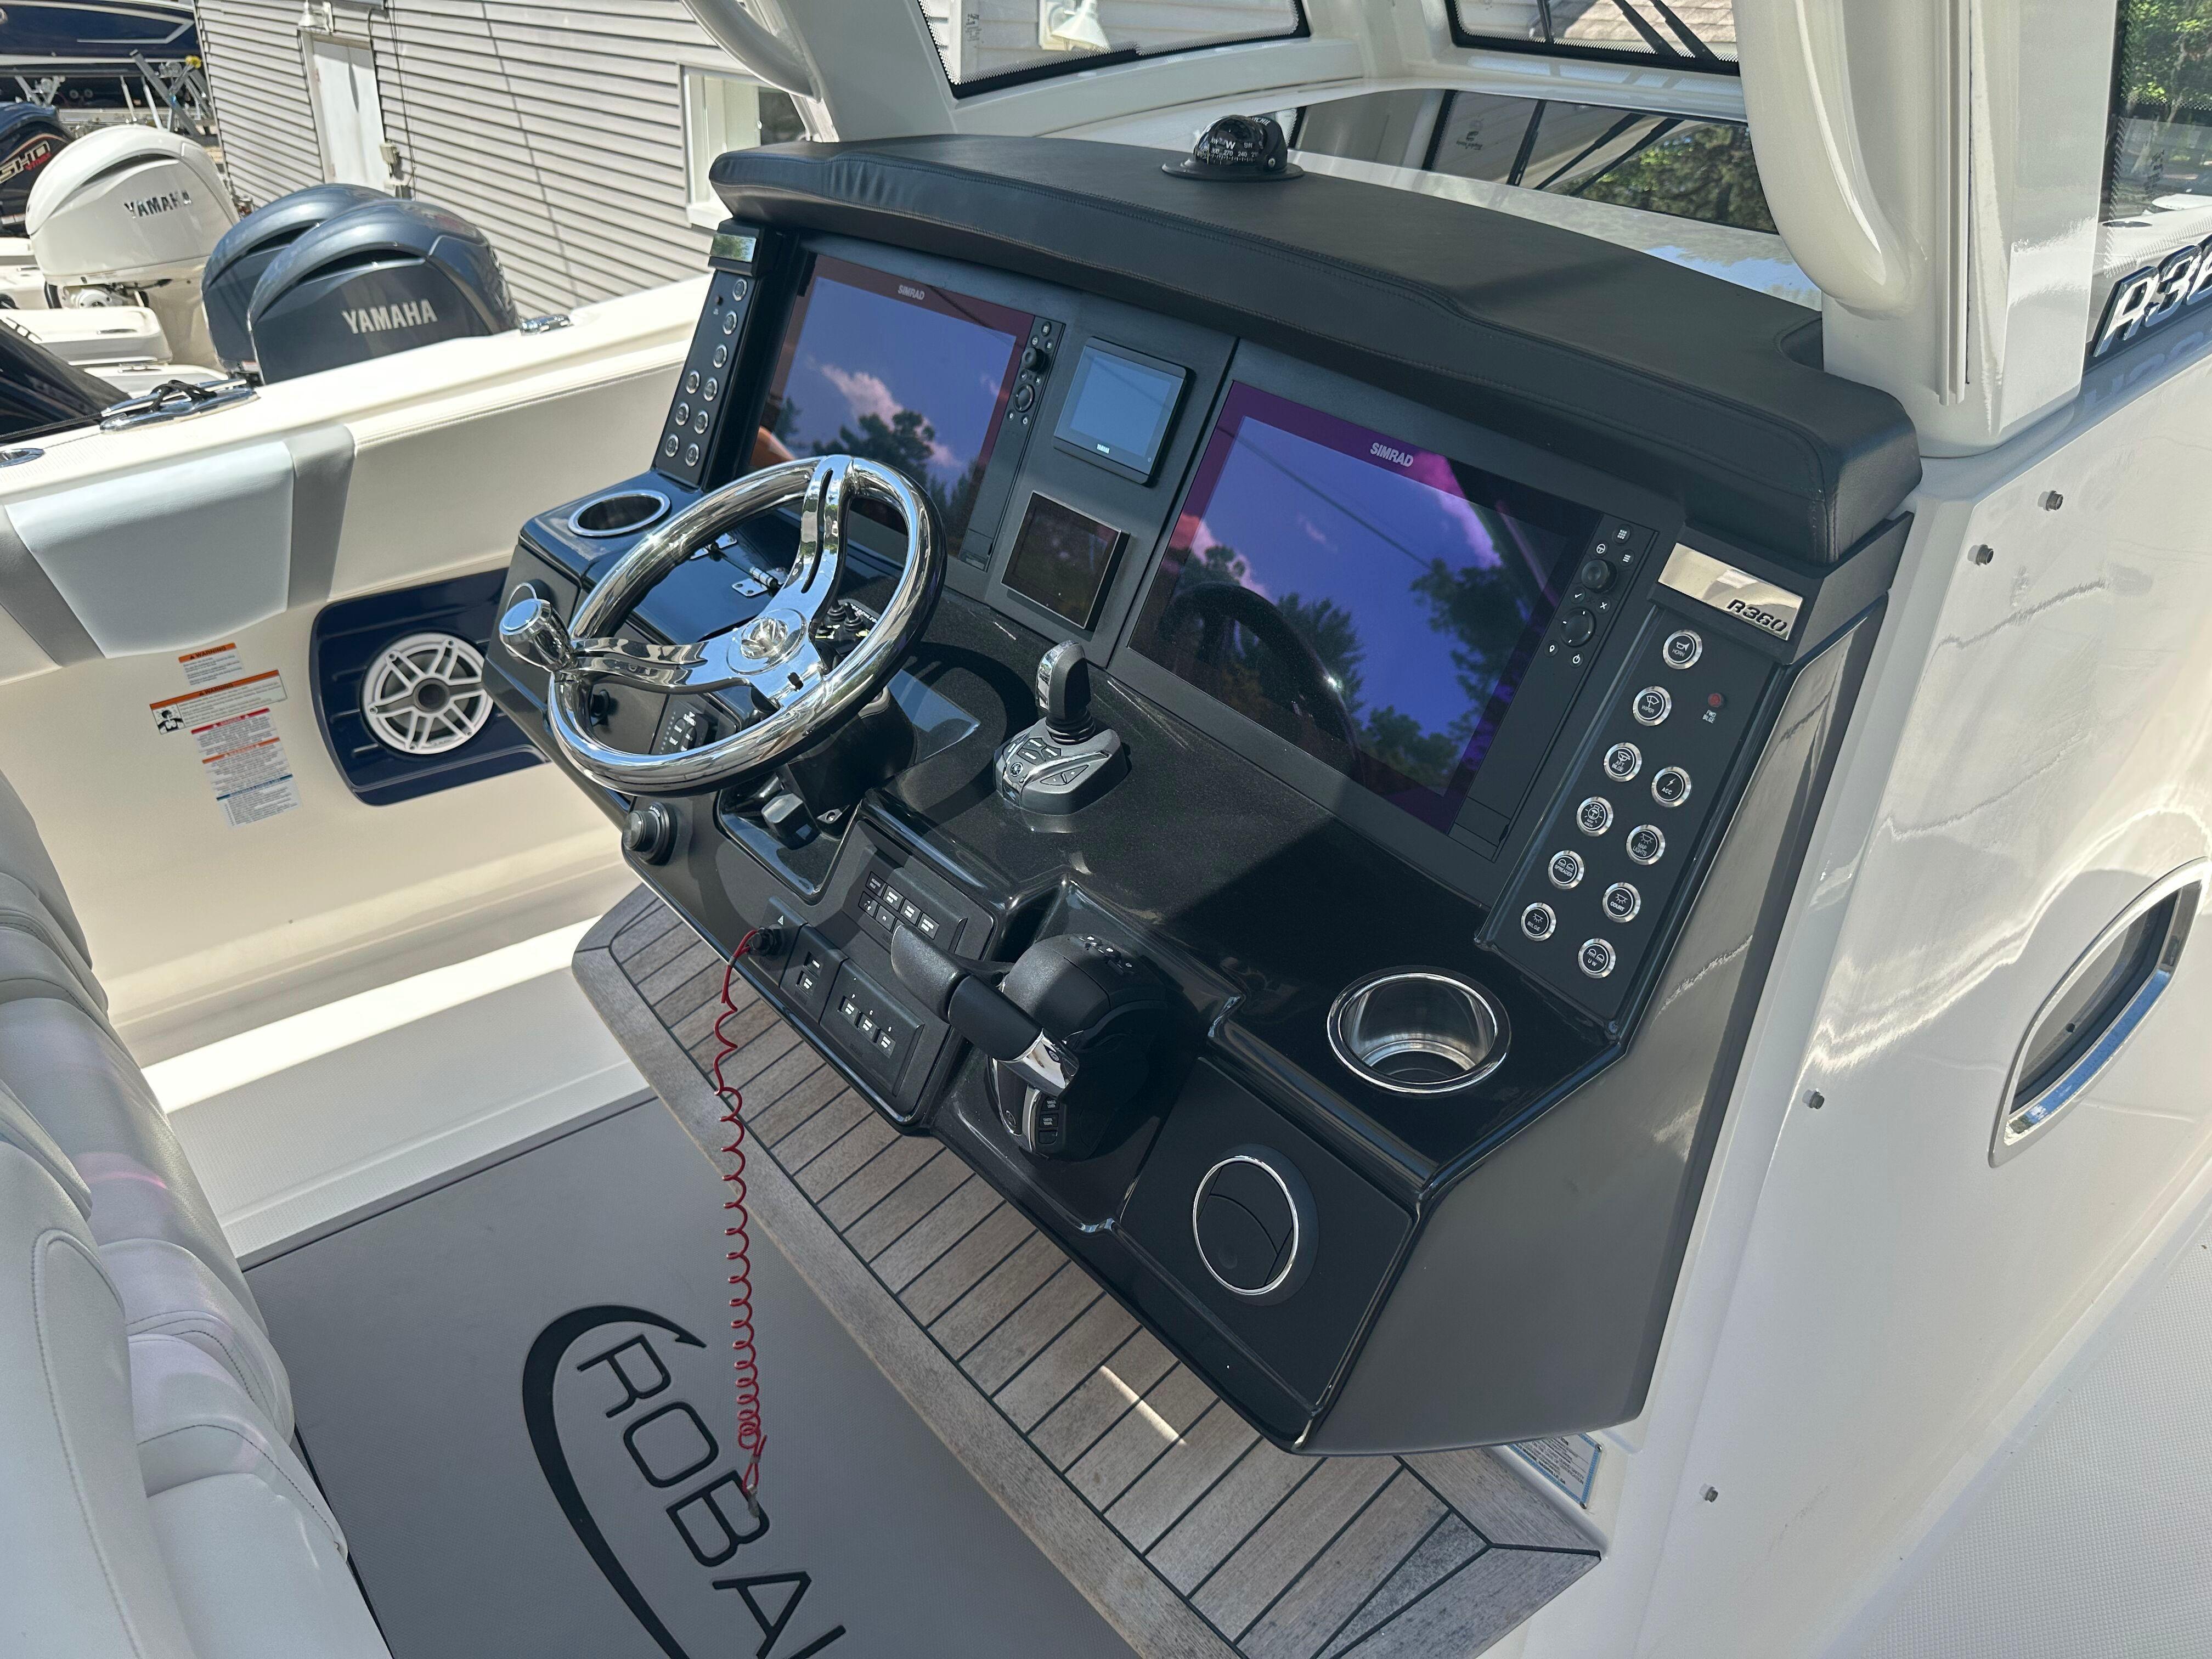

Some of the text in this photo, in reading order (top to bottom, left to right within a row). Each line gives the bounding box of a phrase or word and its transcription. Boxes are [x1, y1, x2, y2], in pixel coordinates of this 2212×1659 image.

[1226, 140, 1235, 150] W
[123, 190, 192, 219] YAMAHA
[898, 285, 925, 301] SIMRAD
[341, 298, 438, 334] YAMAHA
[1370, 442, 1414, 467] SIMRAD
[1726, 599, 1787, 632] R360
[195, 645, 227, 658] WARNING
[1672, 648, 1685, 657] HORN
[203, 683, 234, 695] WARNING
[1641, 705, 1655, 714] WIPER
[1706, 709, 1716, 718] FWD
[1661, 787, 1673, 795] ACC
[1554, 864, 1573, 877] SPREADER
[1610, 901, 1626, 912] COURT
[1527, 921, 1541, 932] BILGE
